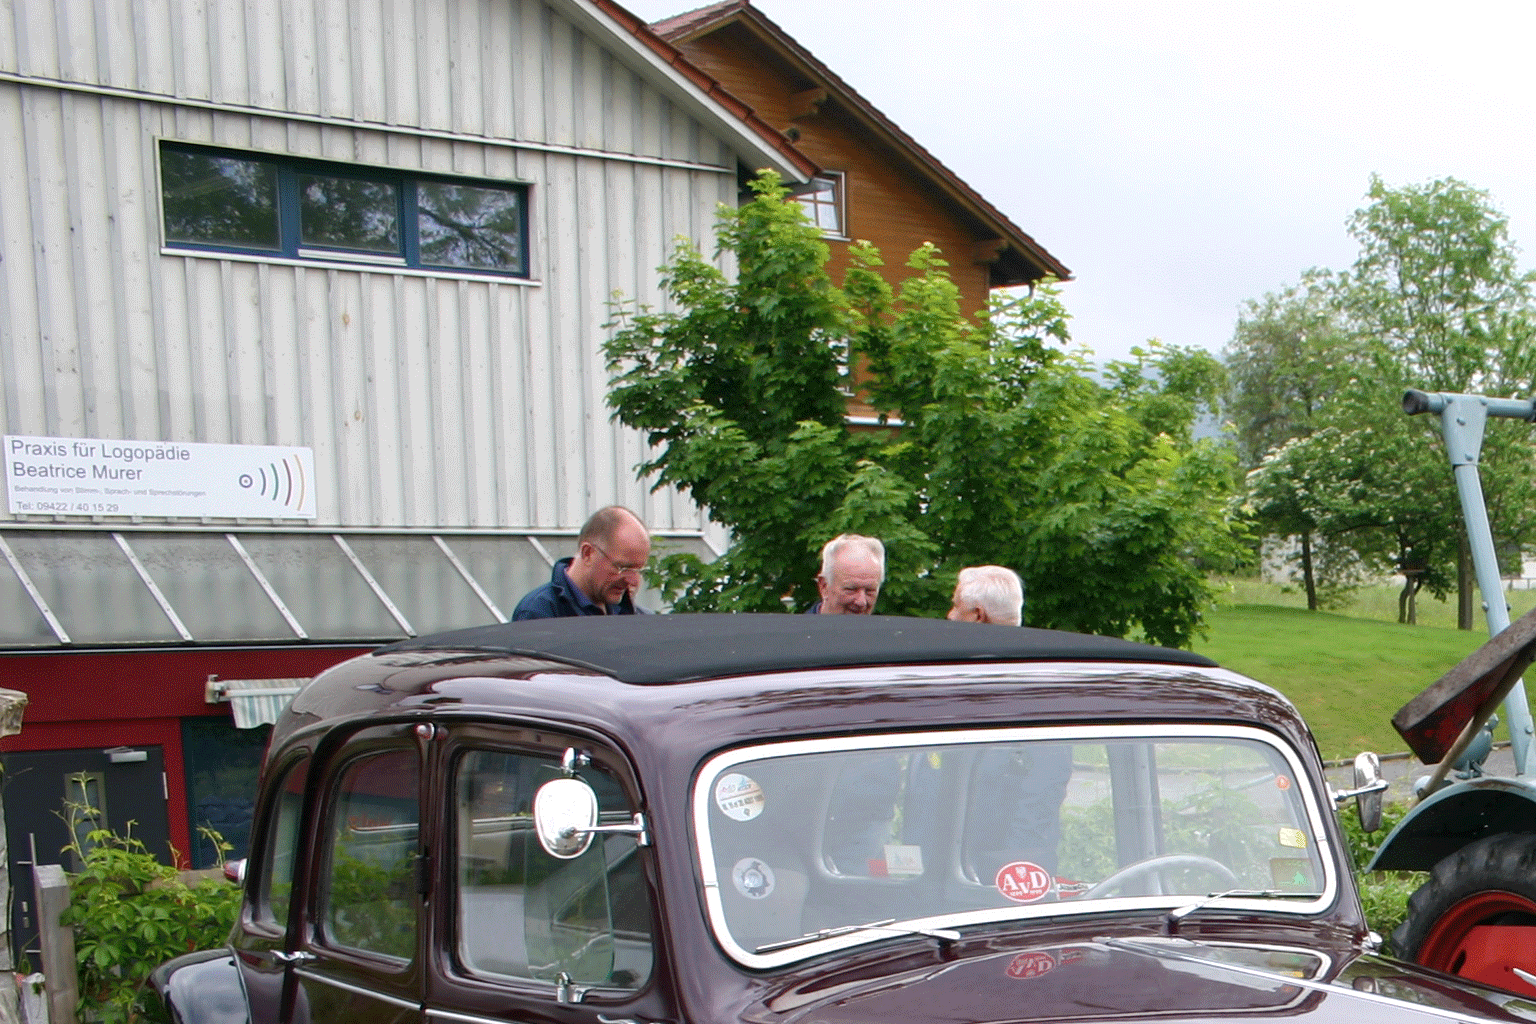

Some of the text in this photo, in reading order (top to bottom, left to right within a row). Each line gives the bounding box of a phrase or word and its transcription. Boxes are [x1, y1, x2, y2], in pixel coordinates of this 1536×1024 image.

[11, 440, 190, 462] Praxis für Logopädie
[13, 462, 143, 480] Beatrice Murer
[37, 502, 67, 511] 09422
[76, 502, 89, 511] 40
[93, 503, 104, 511] 15
[107, 503, 119, 512] 29
